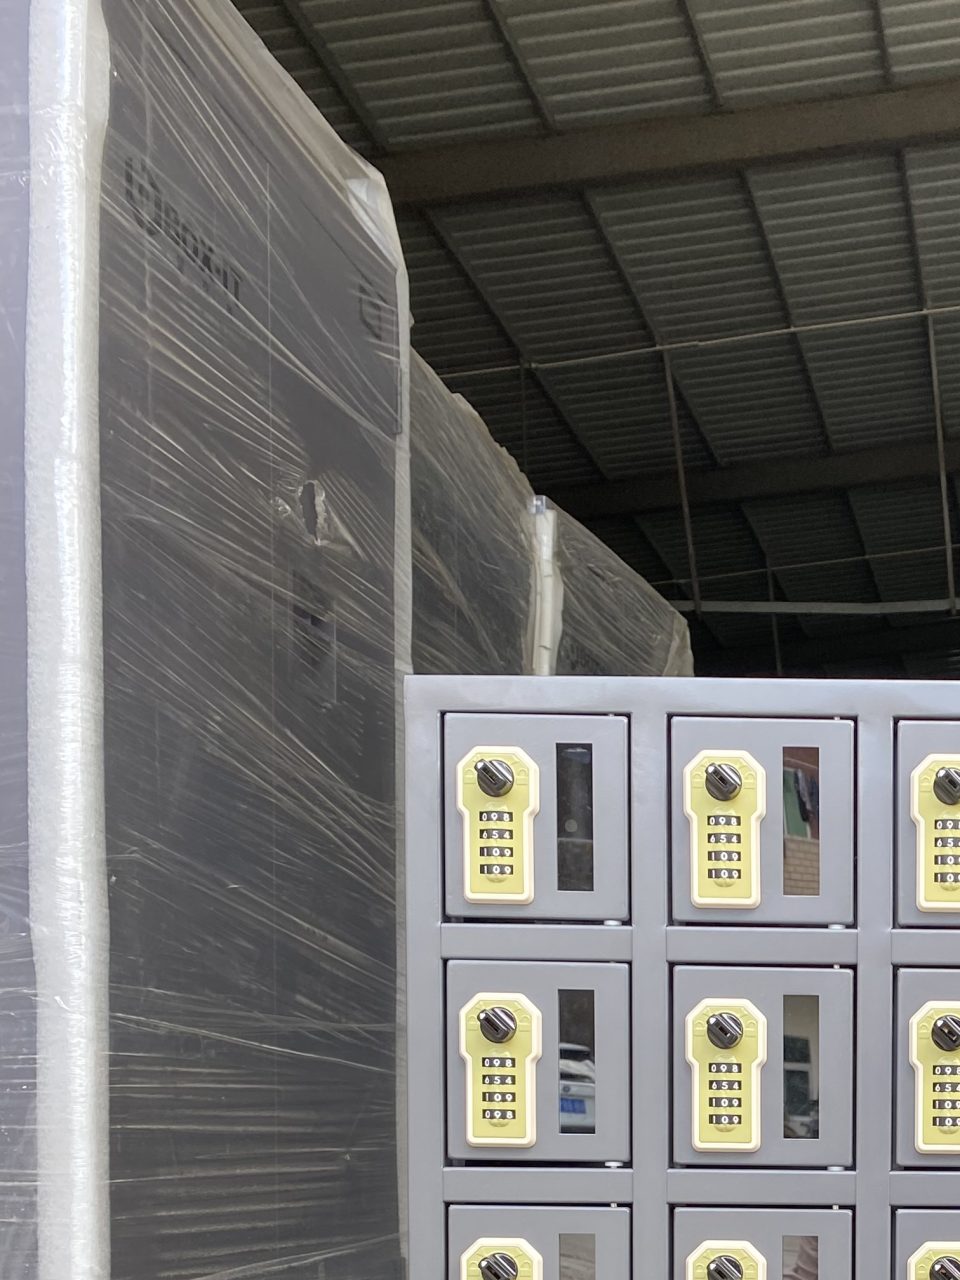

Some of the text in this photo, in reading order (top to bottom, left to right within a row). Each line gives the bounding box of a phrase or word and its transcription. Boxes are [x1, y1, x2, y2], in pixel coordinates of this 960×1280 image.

[481, 811, 510, 822] 098
[709, 815, 738, 826] 098
[482, 830, 510, 839] 654
[710, 833, 738, 843] 654
[483, 848, 512, 857] 109
[711, 852, 739, 861] 109
[484, 864, 512, 874] 109
[711, 870, 739, 879] 109
[484, 1057, 513, 1067] 098
[711, 1064, 739, 1073] 098
[484, 1076, 512, 1085] 654
[711, 1082, 739, 1090] 654
[485, 1093, 513, 1102] 109
[712, 1097, 739, 1107] 109
[485, 1111, 513, 1119] 098
[712, 1114, 739, 1124] 109
